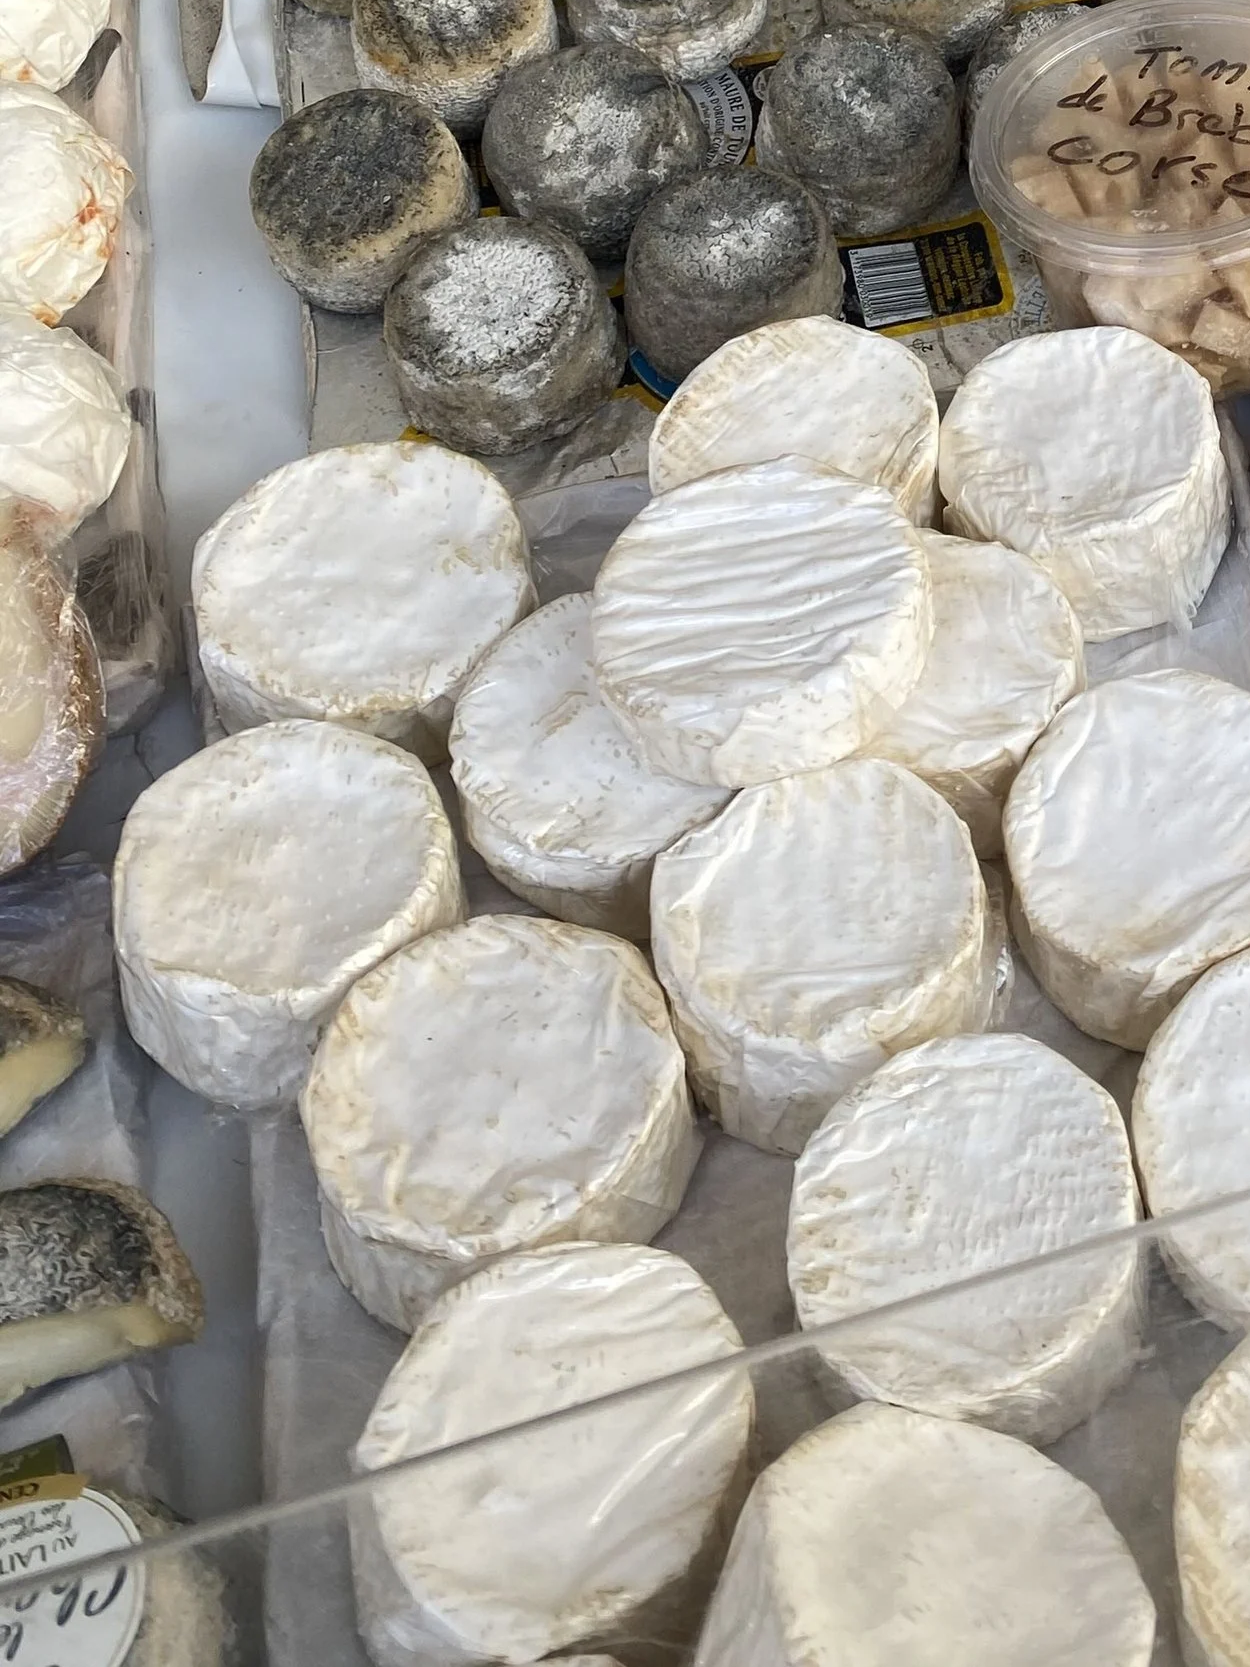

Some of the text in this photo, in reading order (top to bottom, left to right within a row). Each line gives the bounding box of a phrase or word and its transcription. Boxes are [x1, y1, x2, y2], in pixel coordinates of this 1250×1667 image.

[715, 73, 747, 132] MAURE DE
[1057, 74, 1108, 112] de
